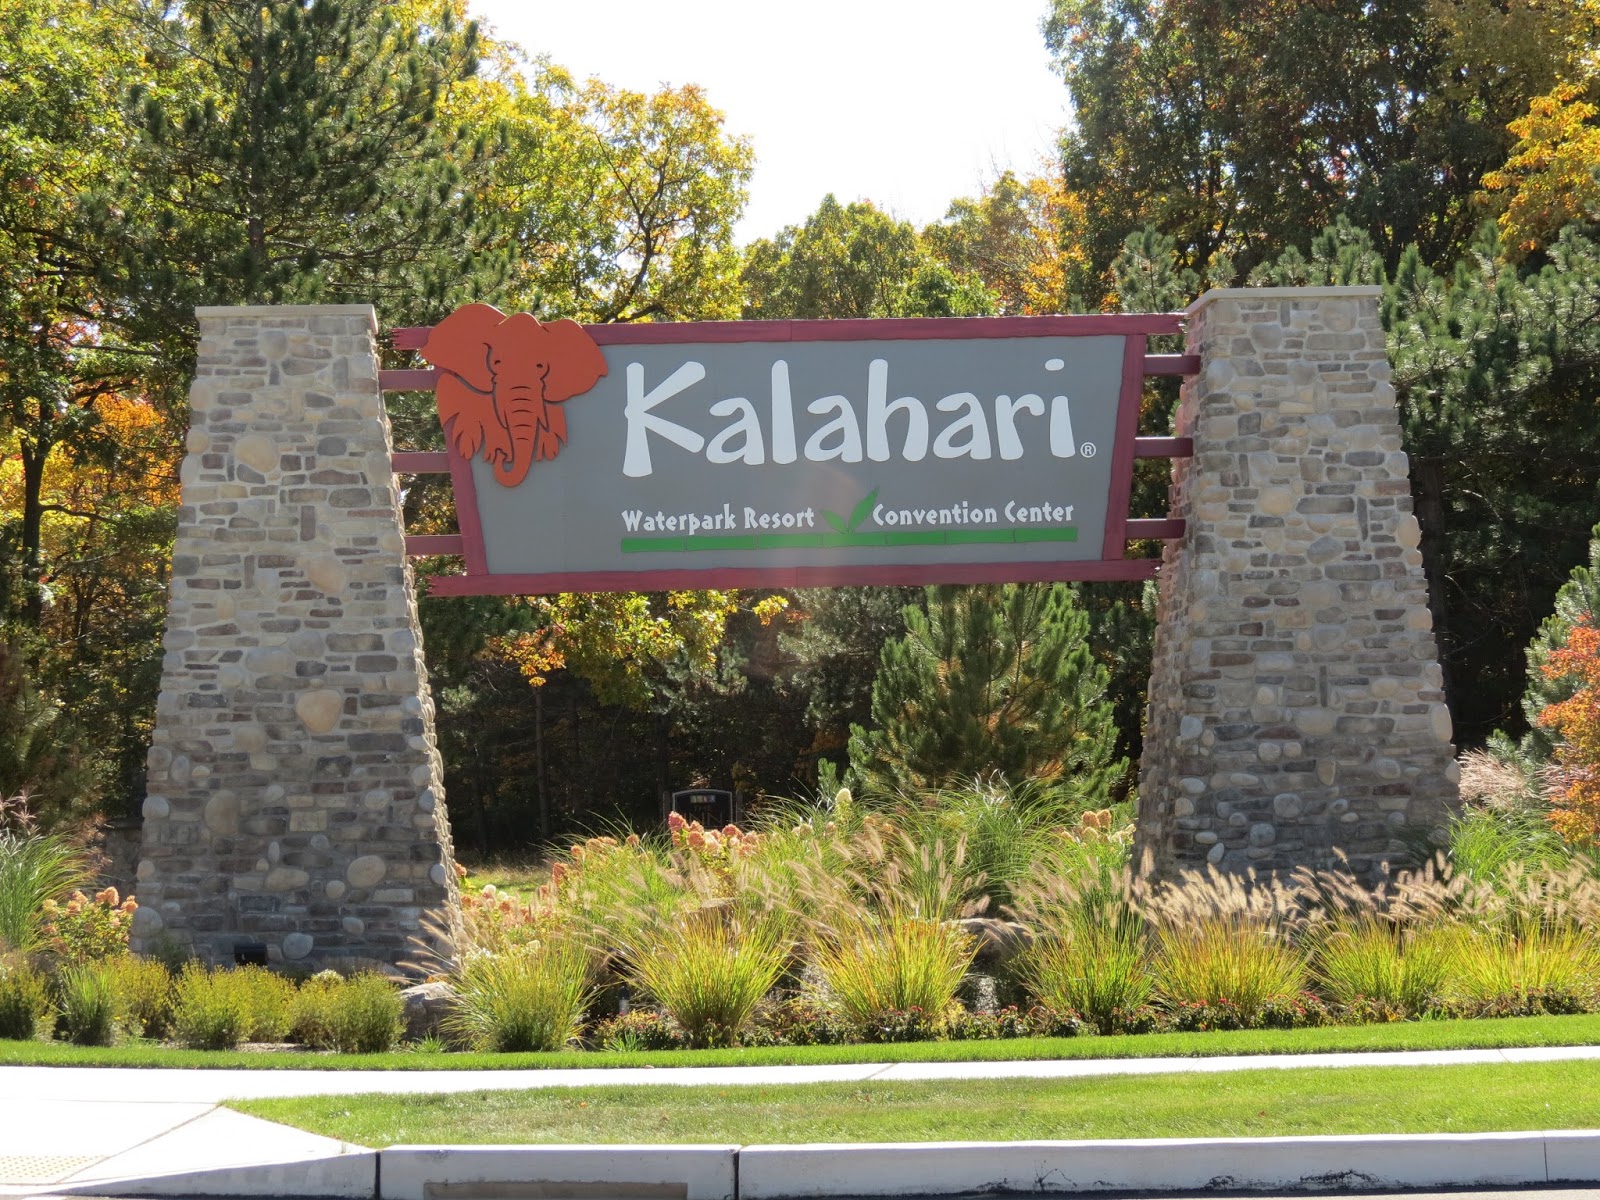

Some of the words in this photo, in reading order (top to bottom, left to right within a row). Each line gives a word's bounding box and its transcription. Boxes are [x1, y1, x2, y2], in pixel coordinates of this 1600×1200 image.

[621, 502, 737, 536] Waterpark
[743, 506, 815, 529] Resort
[872, 500, 998, 527] Convention
[1004, 500, 1074, 523] Center
